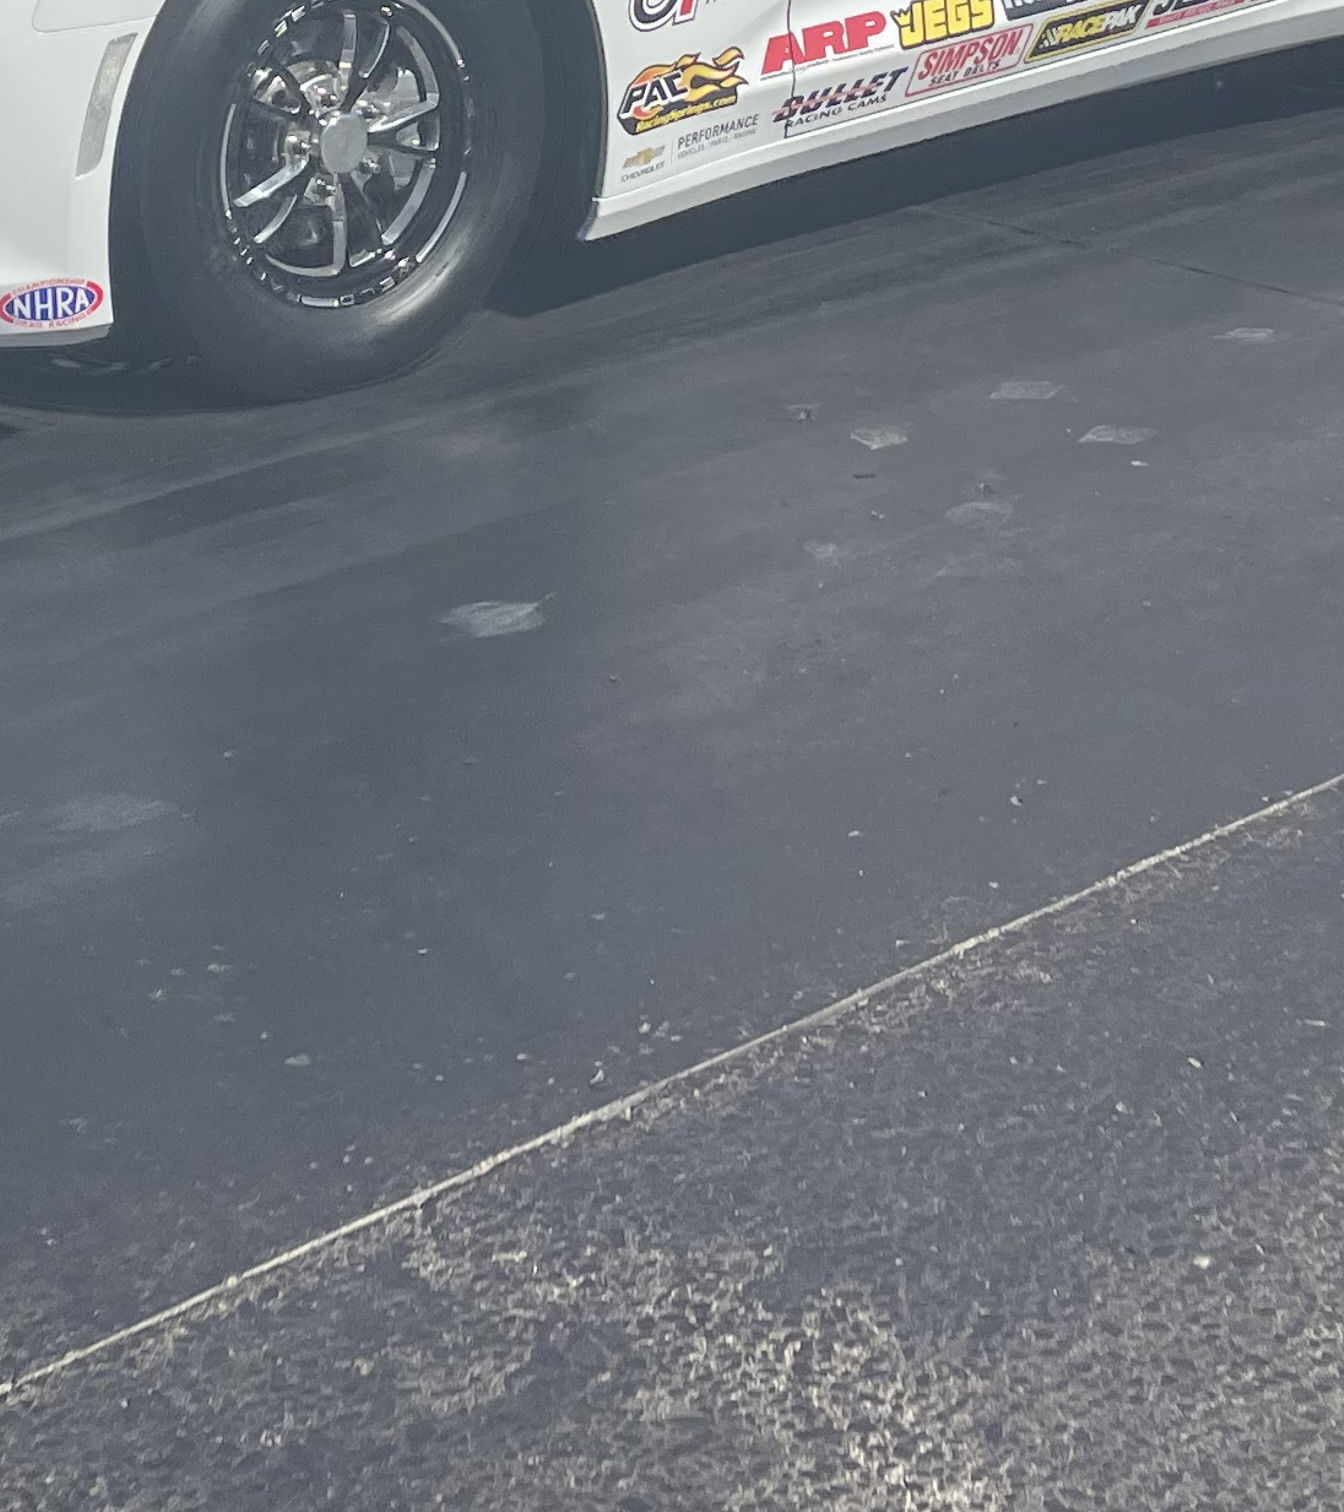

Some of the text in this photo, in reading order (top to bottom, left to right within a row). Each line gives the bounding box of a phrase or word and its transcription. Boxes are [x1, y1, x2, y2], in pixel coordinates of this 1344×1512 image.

[760, 10, 888, 76] ARP
[917, 31, 1022, 80] SIMPSON
[929, 59, 1000, 86] SEAT BELTS
[621, 71, 689, 115] PAC
[772, 66, 909, 123] BULLET
[784, 93, 888, 129] RACING CAMS
[676, 113, 759, 150] PERFORMANCE
[620, 161, 666, 183] CHEVROLET
[13, 287, 91, 322] NHRA
[48, 314, 87, 328] RACING
